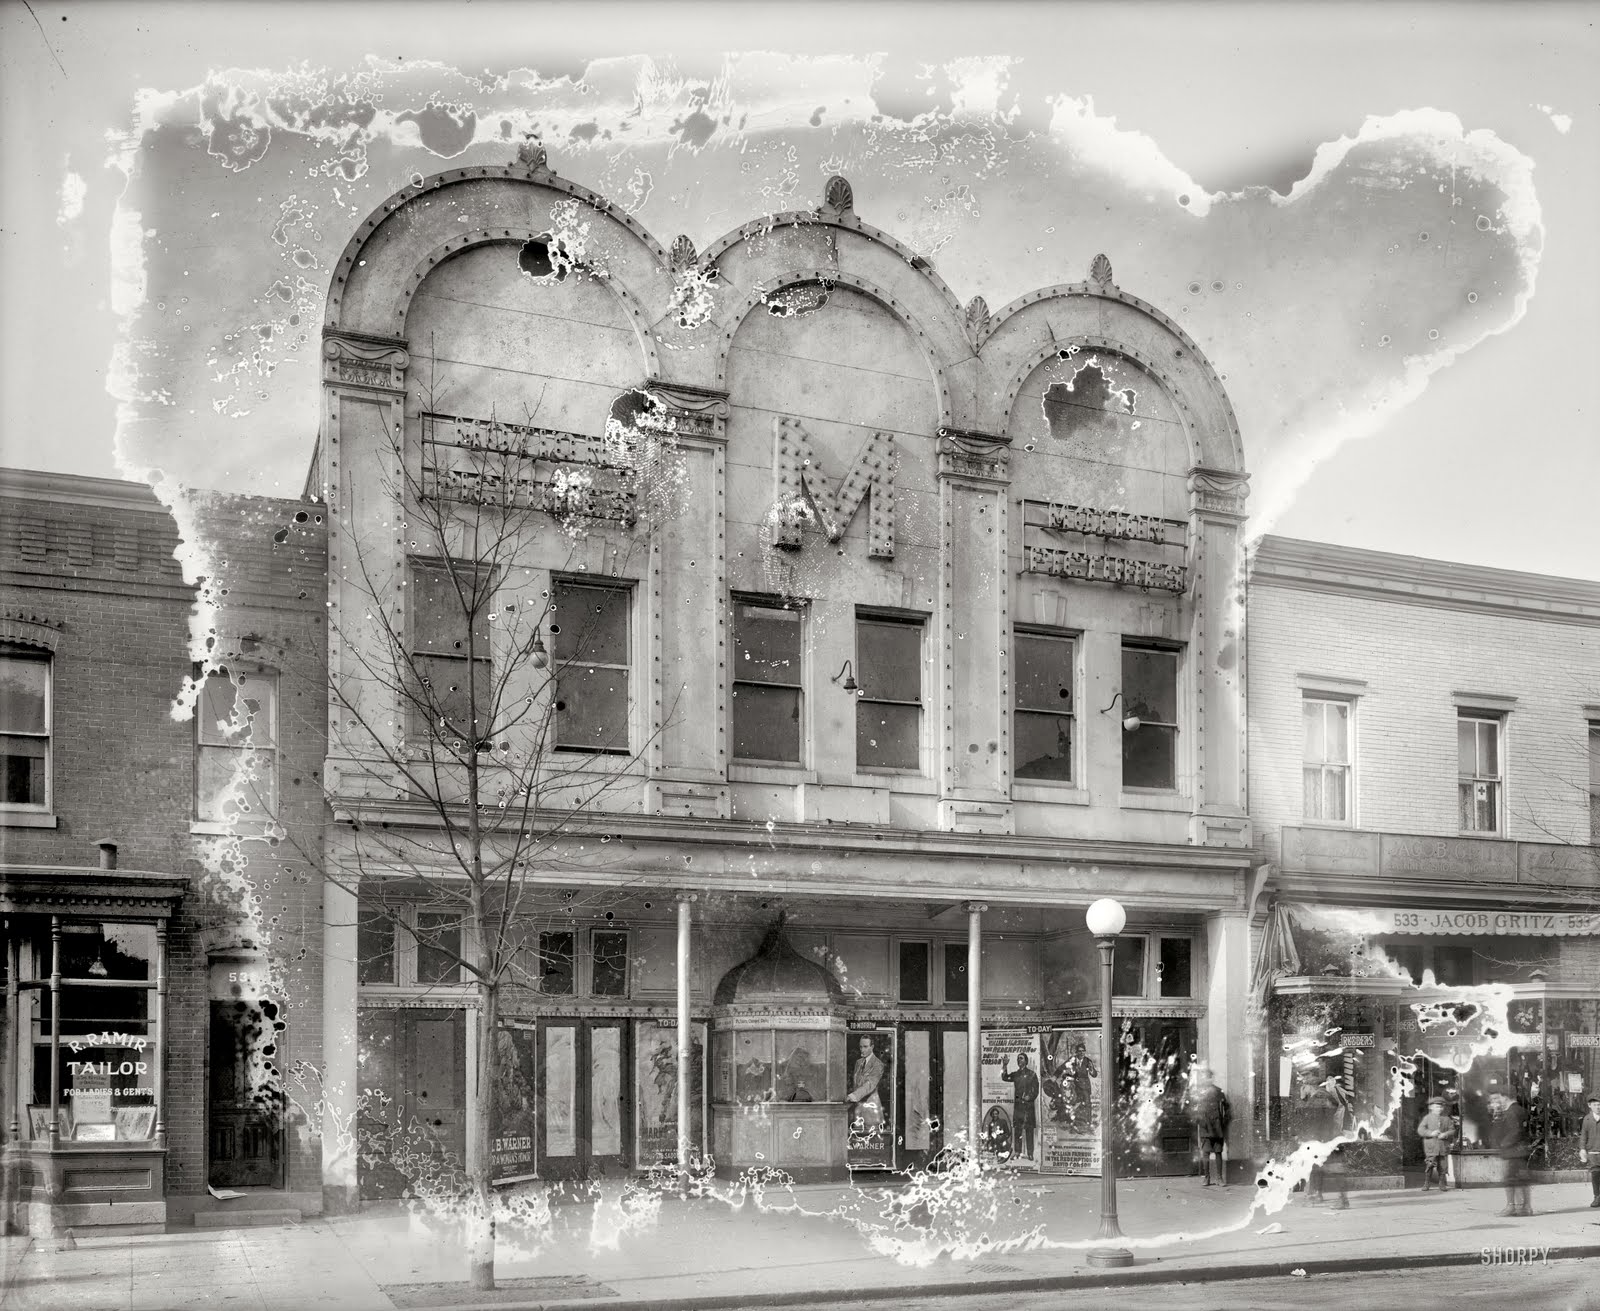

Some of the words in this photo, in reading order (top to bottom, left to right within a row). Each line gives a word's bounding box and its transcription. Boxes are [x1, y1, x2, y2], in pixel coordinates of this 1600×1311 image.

[454, 416, 607, 465] MOTION
[773, 416, 895, 562] M
[1049, 503, 1164, 542] MOTION
[1030, 547, 1183, 589] PICTURES
[1394, 913, 1419, 927] 533
[1430, 914, 1489, 928] JACOB
[1494, 914, 1555, 929] GRITZ
[1568, 915, 1590, 929] 533
[658, 1019, 678, 1027] TO-D
[68, 1040, 86, 1054] R.
[86, 1031, 147, 1053] RAMIR
[66, 1061, 148, 1075] TAILOR
[63, 1088, 80, 1097] FOR
[83, 1088, 112, 1096] LADIES
[114, 1087, 120, 1096] &
[503, 1136, 531, 1150] WARNER
[852, 1142, 885, 1150] WARNER
